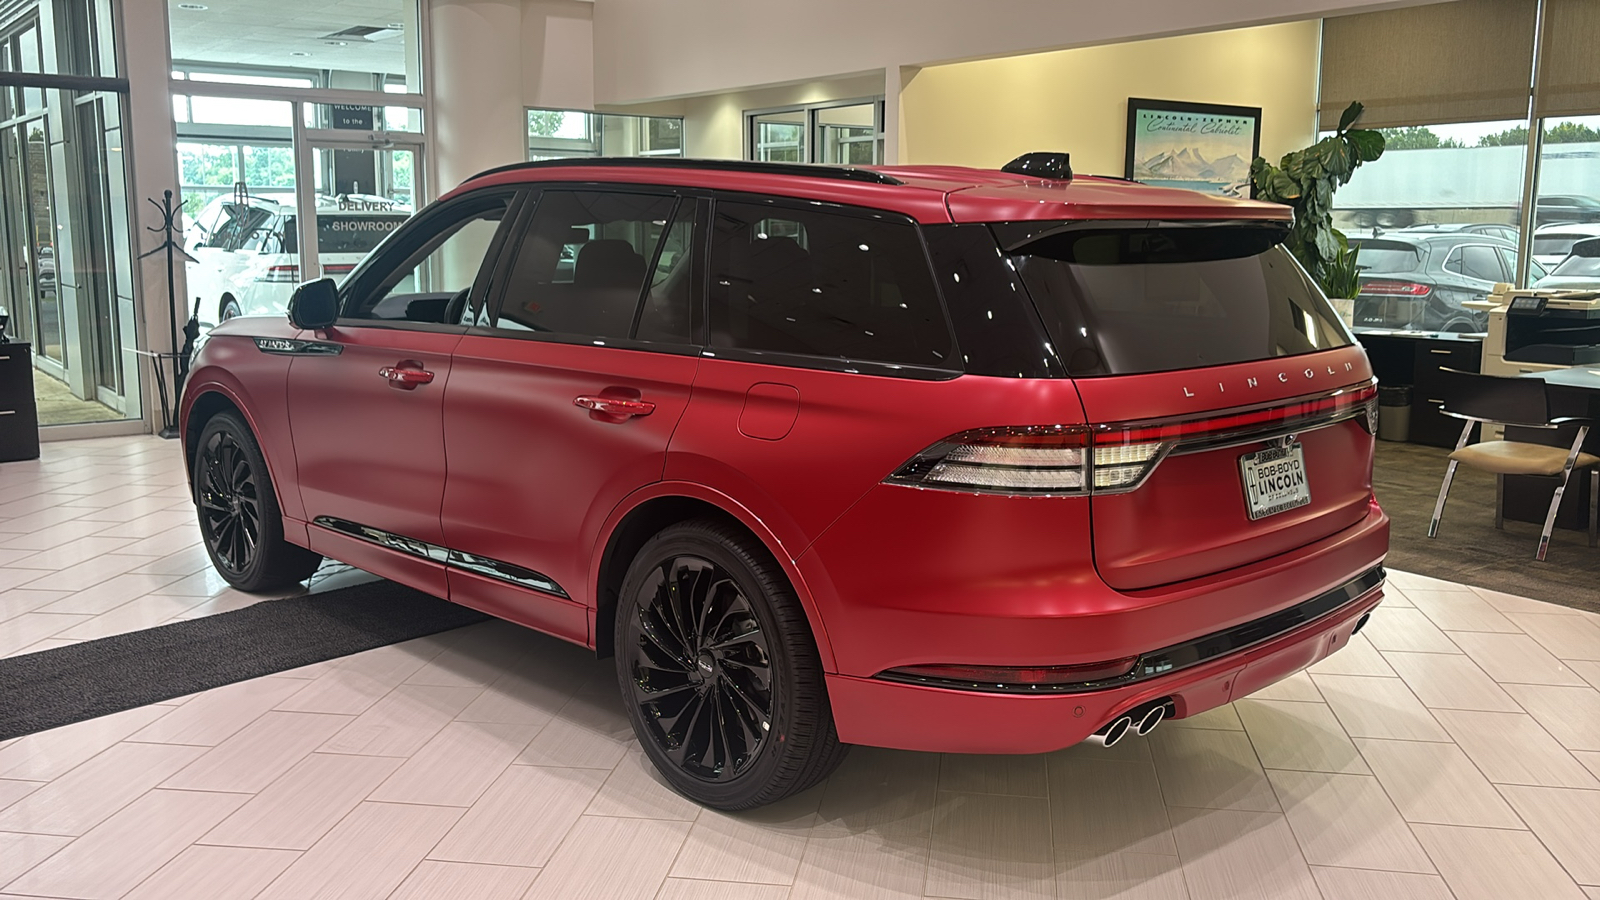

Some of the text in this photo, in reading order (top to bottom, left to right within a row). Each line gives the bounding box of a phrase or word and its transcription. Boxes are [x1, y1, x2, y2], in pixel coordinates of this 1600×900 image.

[1147, 117, 1242, 135] Continental Cabriolet
[339, 202, 394, 211] DELIVERY
[1183, 362, 1353, 397] LINCOLN
[1258, 460, 1300, 479] BOB-BOYD
[1259, 471, 1304, 495] LINCOLN
